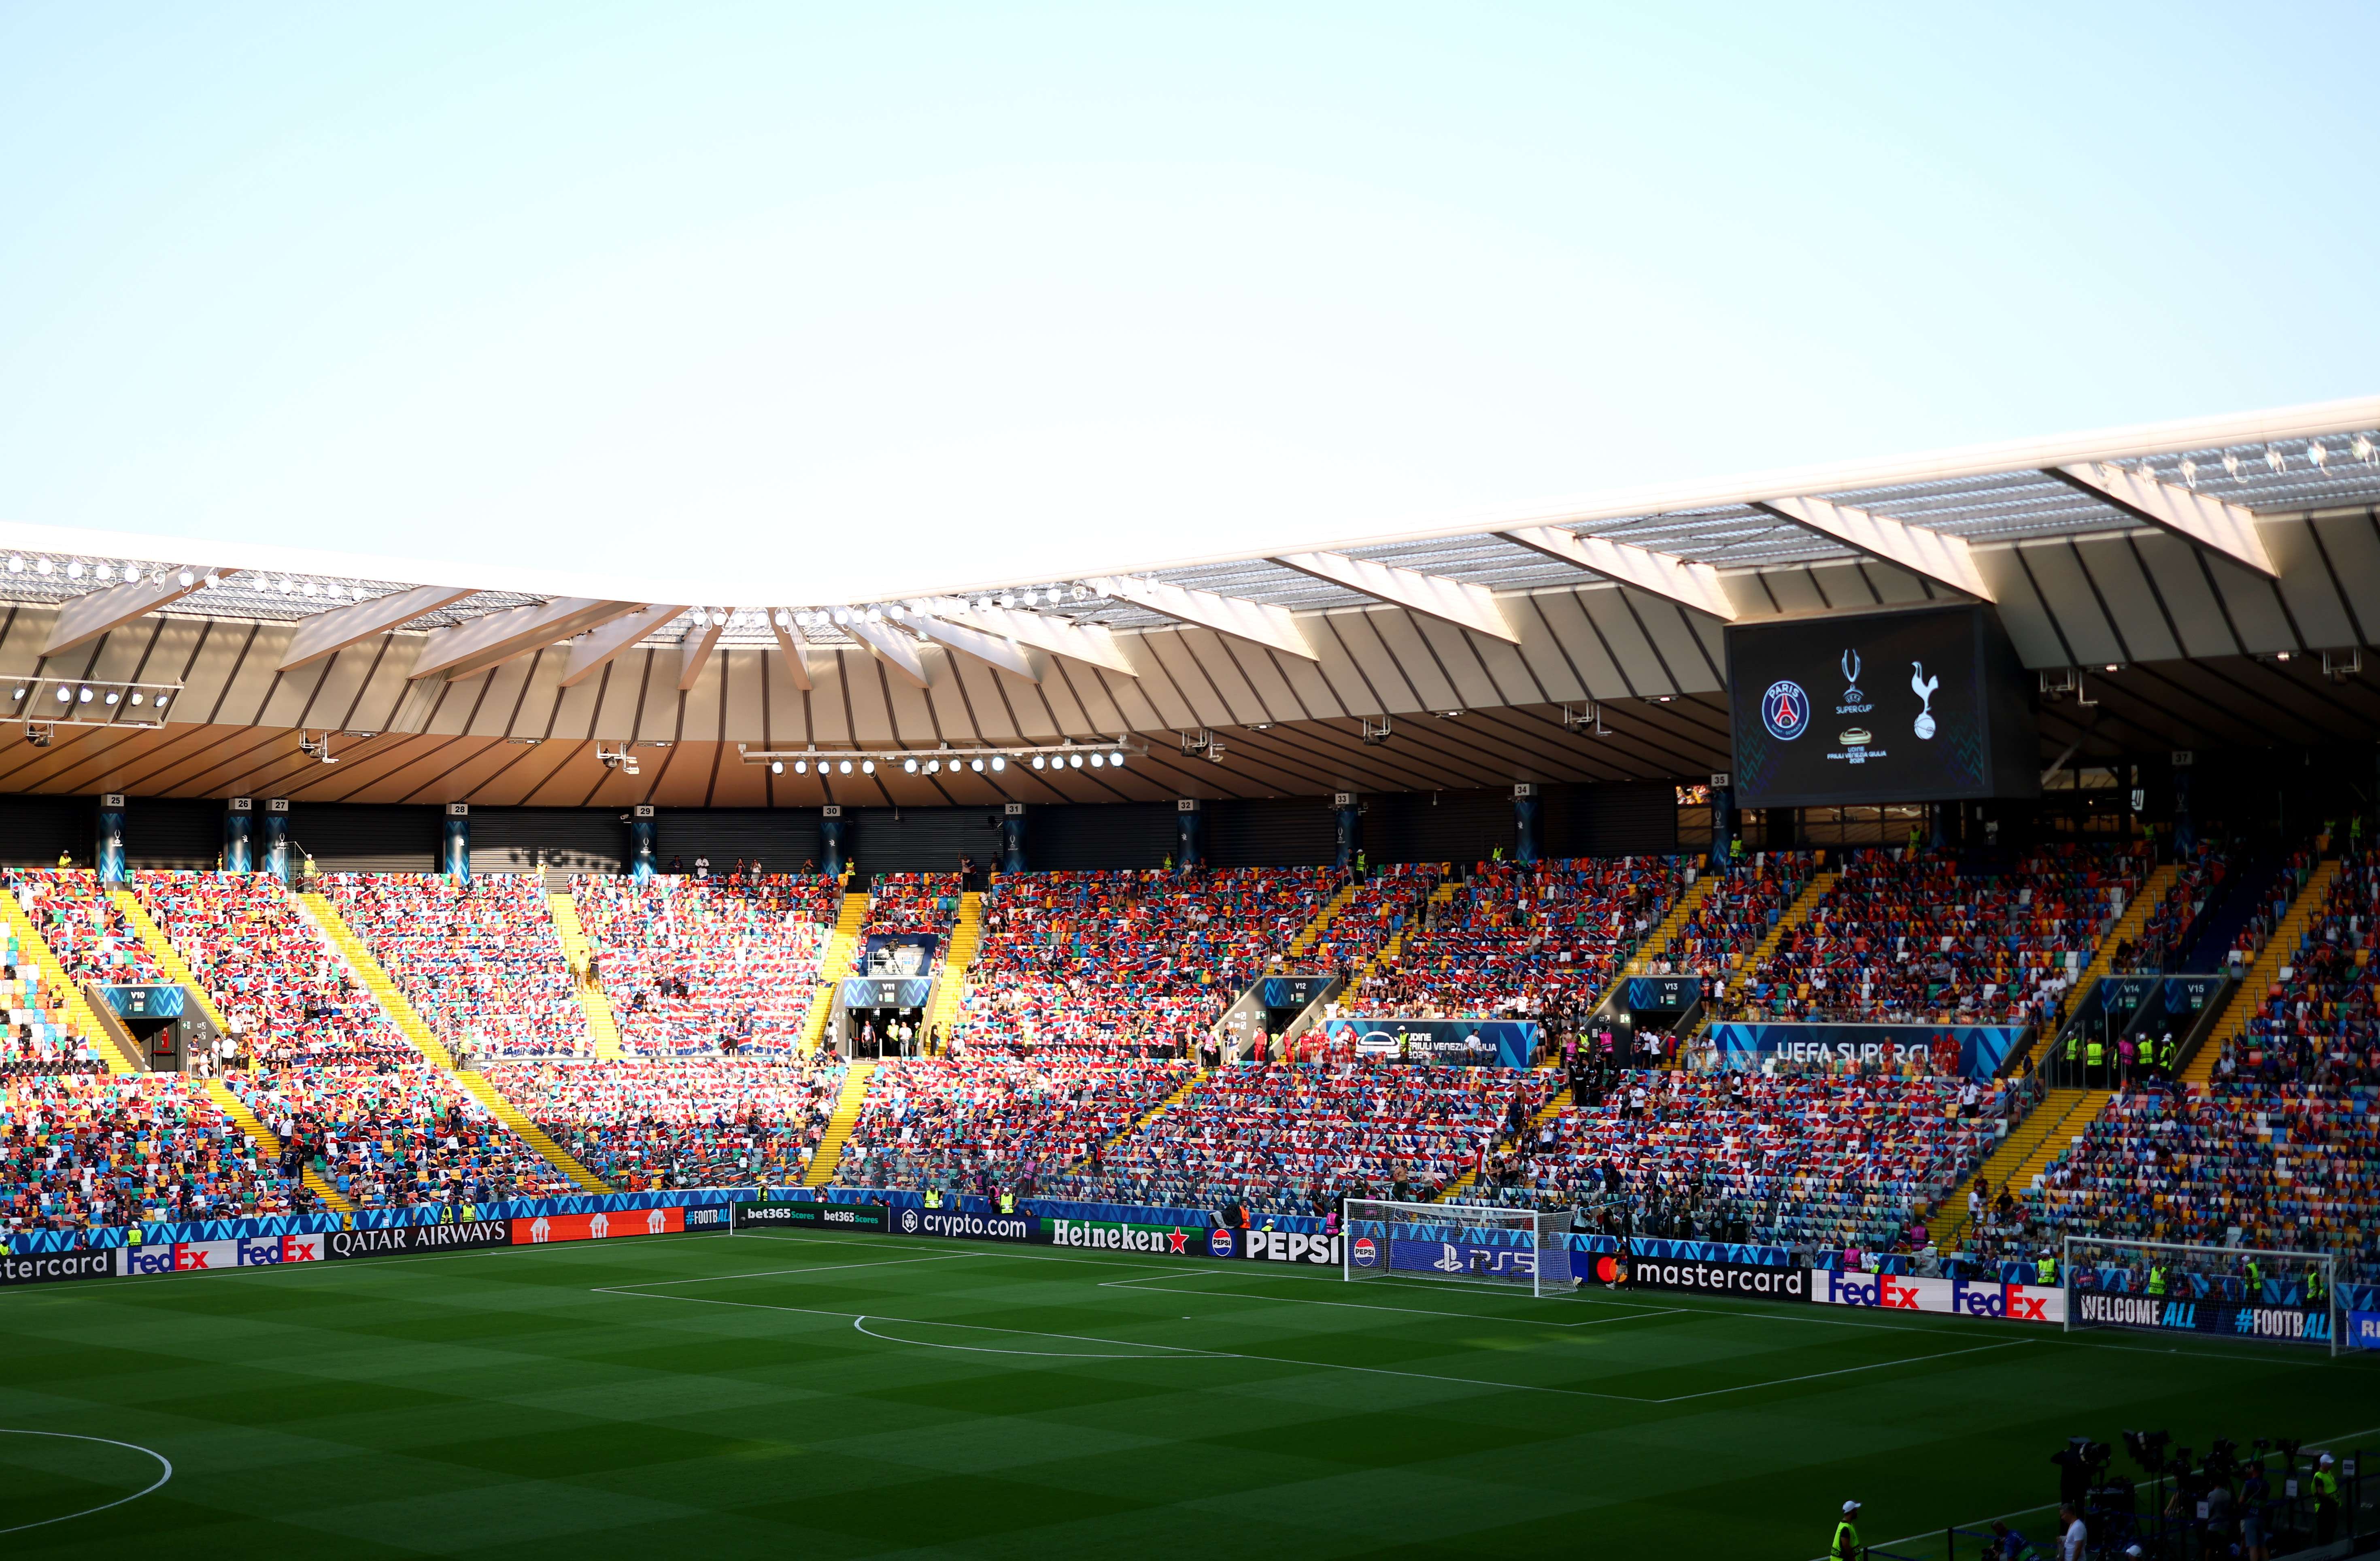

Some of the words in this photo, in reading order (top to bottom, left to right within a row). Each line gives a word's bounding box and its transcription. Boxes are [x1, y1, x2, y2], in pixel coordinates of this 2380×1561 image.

[1768, 683, 1800, 699] PARIS
[2176, 754, 2188, 762] 37
[2188, 985, 2204, 993] V15
[1433, 1042, 1467, 1051] VENEZIA
[1777, 1042, 1832, 1063] UEFA
[333, 1229, 406, 1257] QATAR
[415, 1221, 505, 1246] AIRWAYS
[924, 1214, 1026, 1238] crypto.com
[1053, 1219, 1165, 1252] Heineken
[128, 1242, 209, 1274] FedEx
[238, 1235, 316, 1266] FedEx
[1247, 1230, 1339, 1264] PEPSI
[1470, 1250, 1535, 1273] PS5
[0, 1251, 107, 1279] tercard
[1637, 1263, 1802, 1294] mastercard
[1829, 1270, 1919, 1309] FedEx
[1952, 1279, 2047, 1321] FedEx
[2081, 1295, 2160, 1326] WELCOME
[2162, 1302, 2195, 1329] ALL
